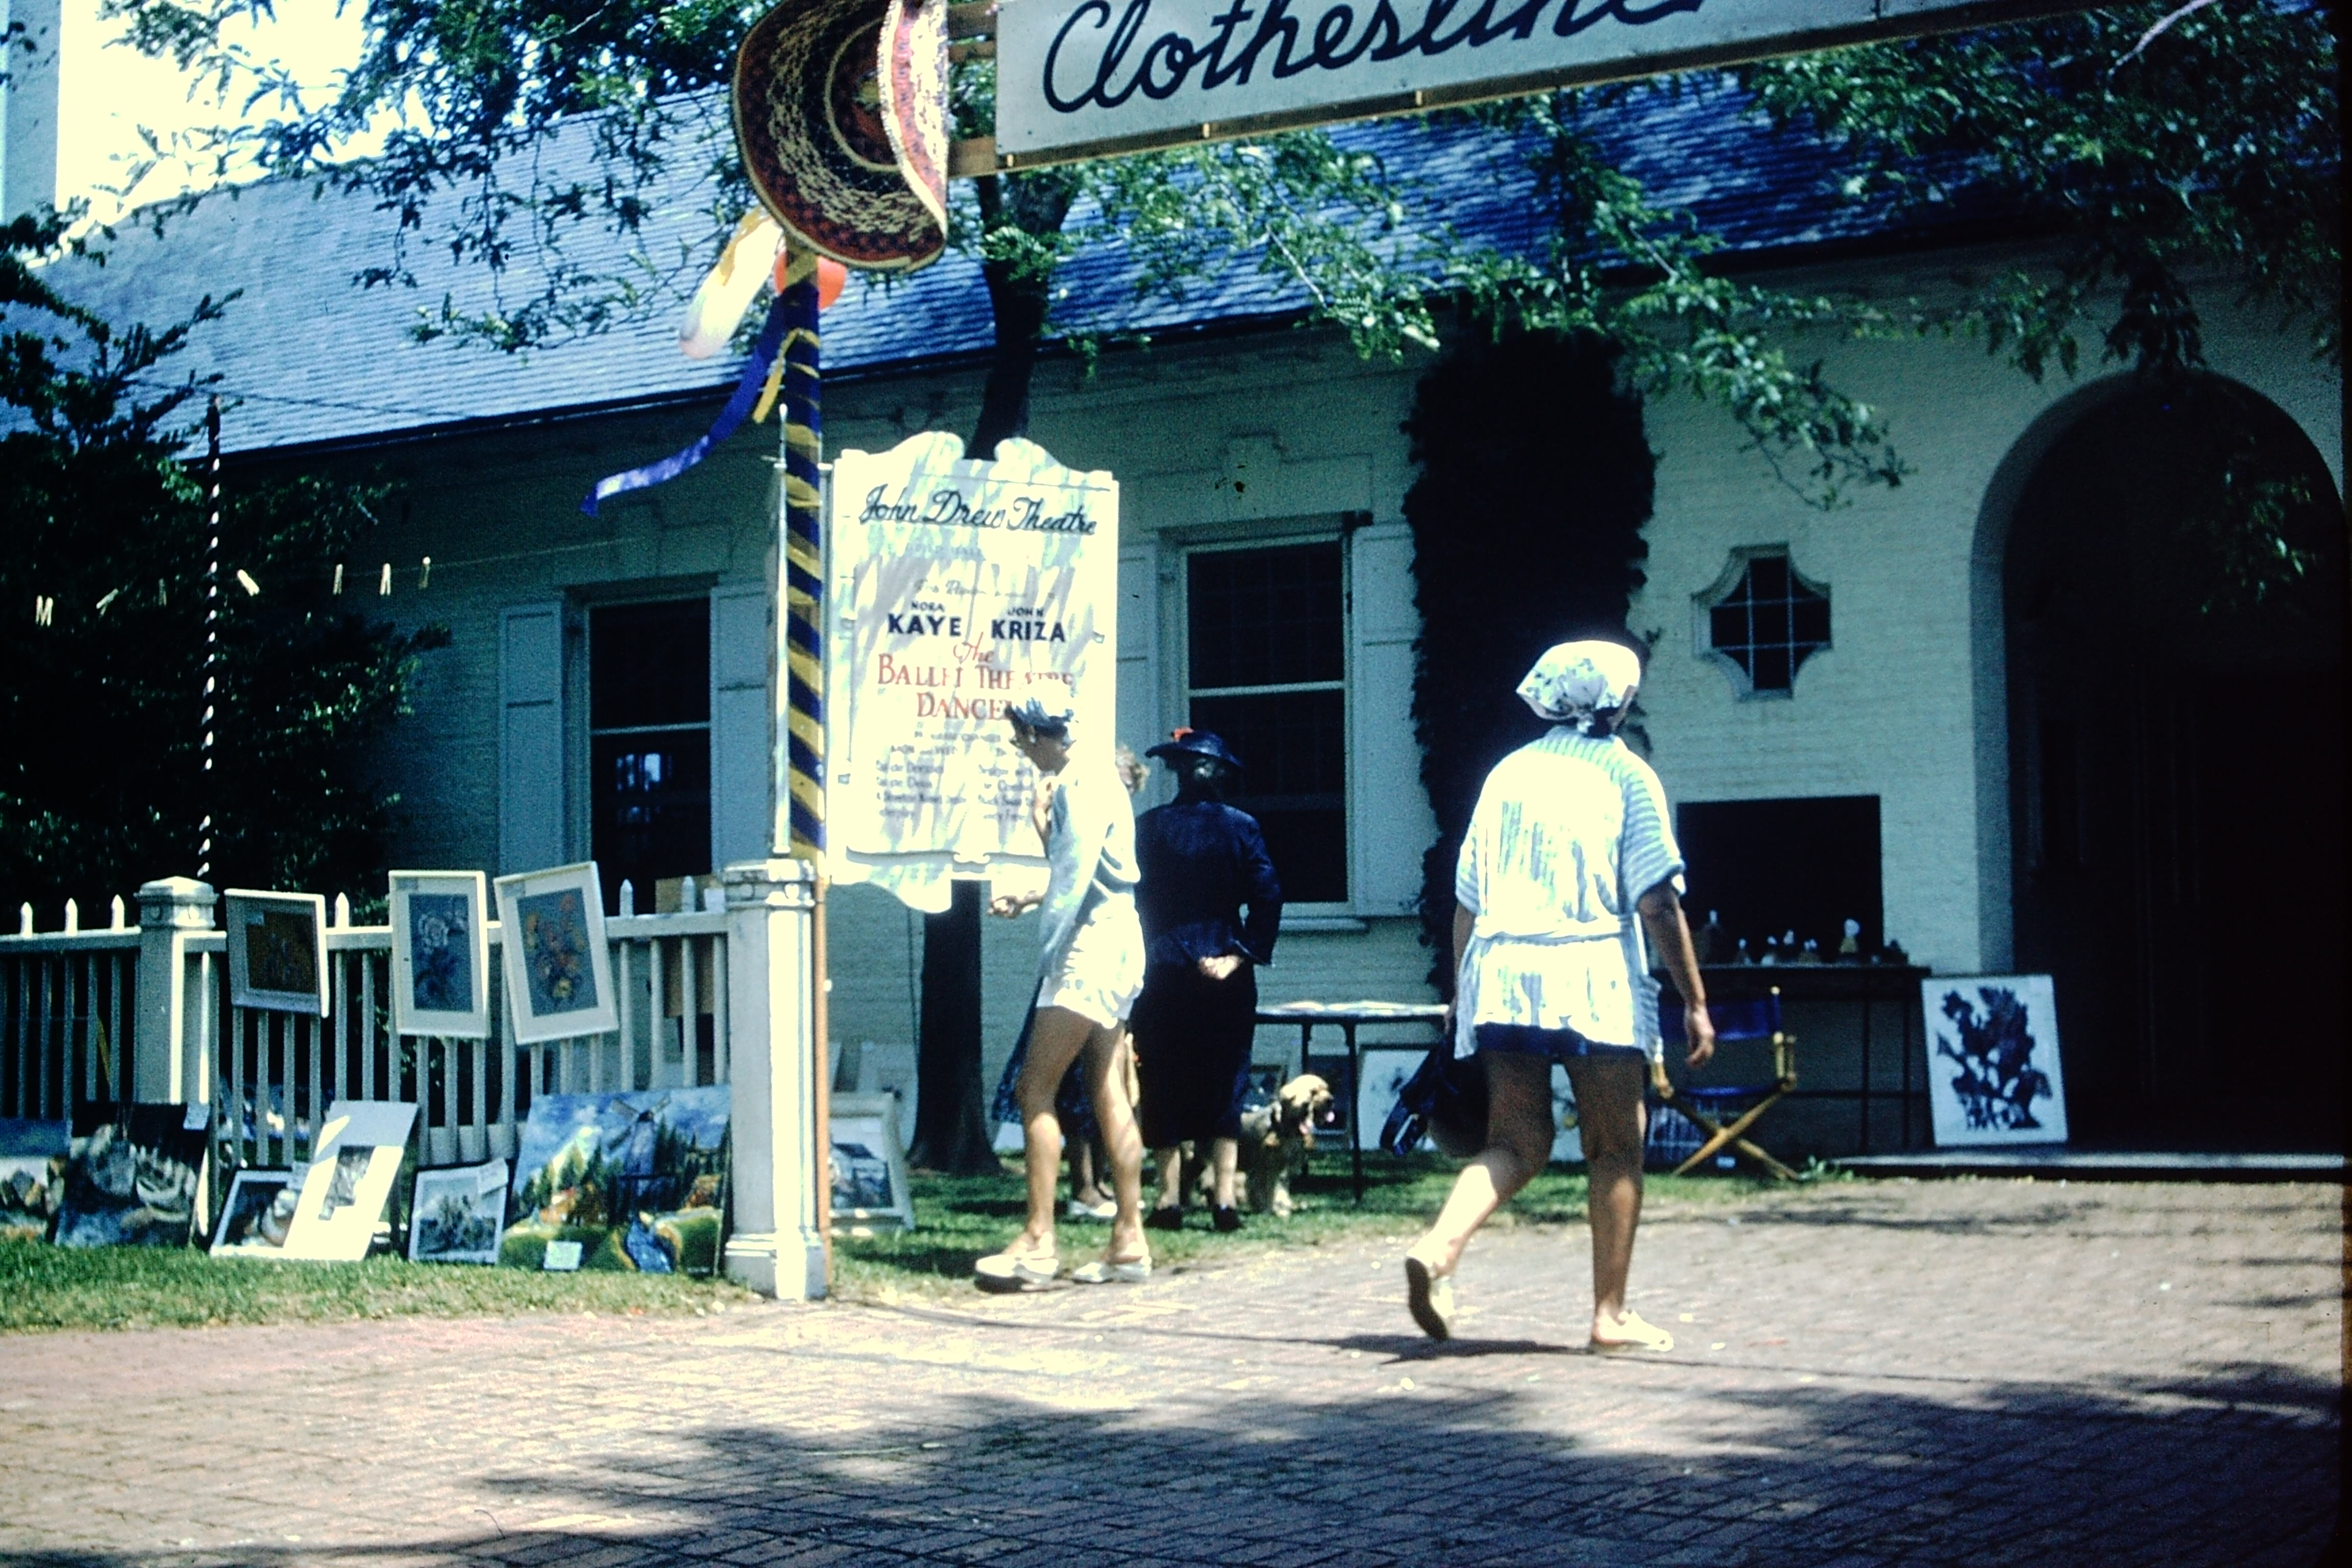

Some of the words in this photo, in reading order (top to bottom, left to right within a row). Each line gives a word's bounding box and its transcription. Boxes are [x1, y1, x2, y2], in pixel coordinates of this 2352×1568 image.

[857, 482, 920, 525] John
[923, 489, 1006, 529] Drew
[1007, 497, 1097, 535] Theatre
[911, 601, 945, 612] NORA
[1008, 607, 1044, 618] JOHN
[887, 613, 962, 637] KAYE
[991, 619, 1066, 643] KRIZA
[953, 631, 994, 664] The
